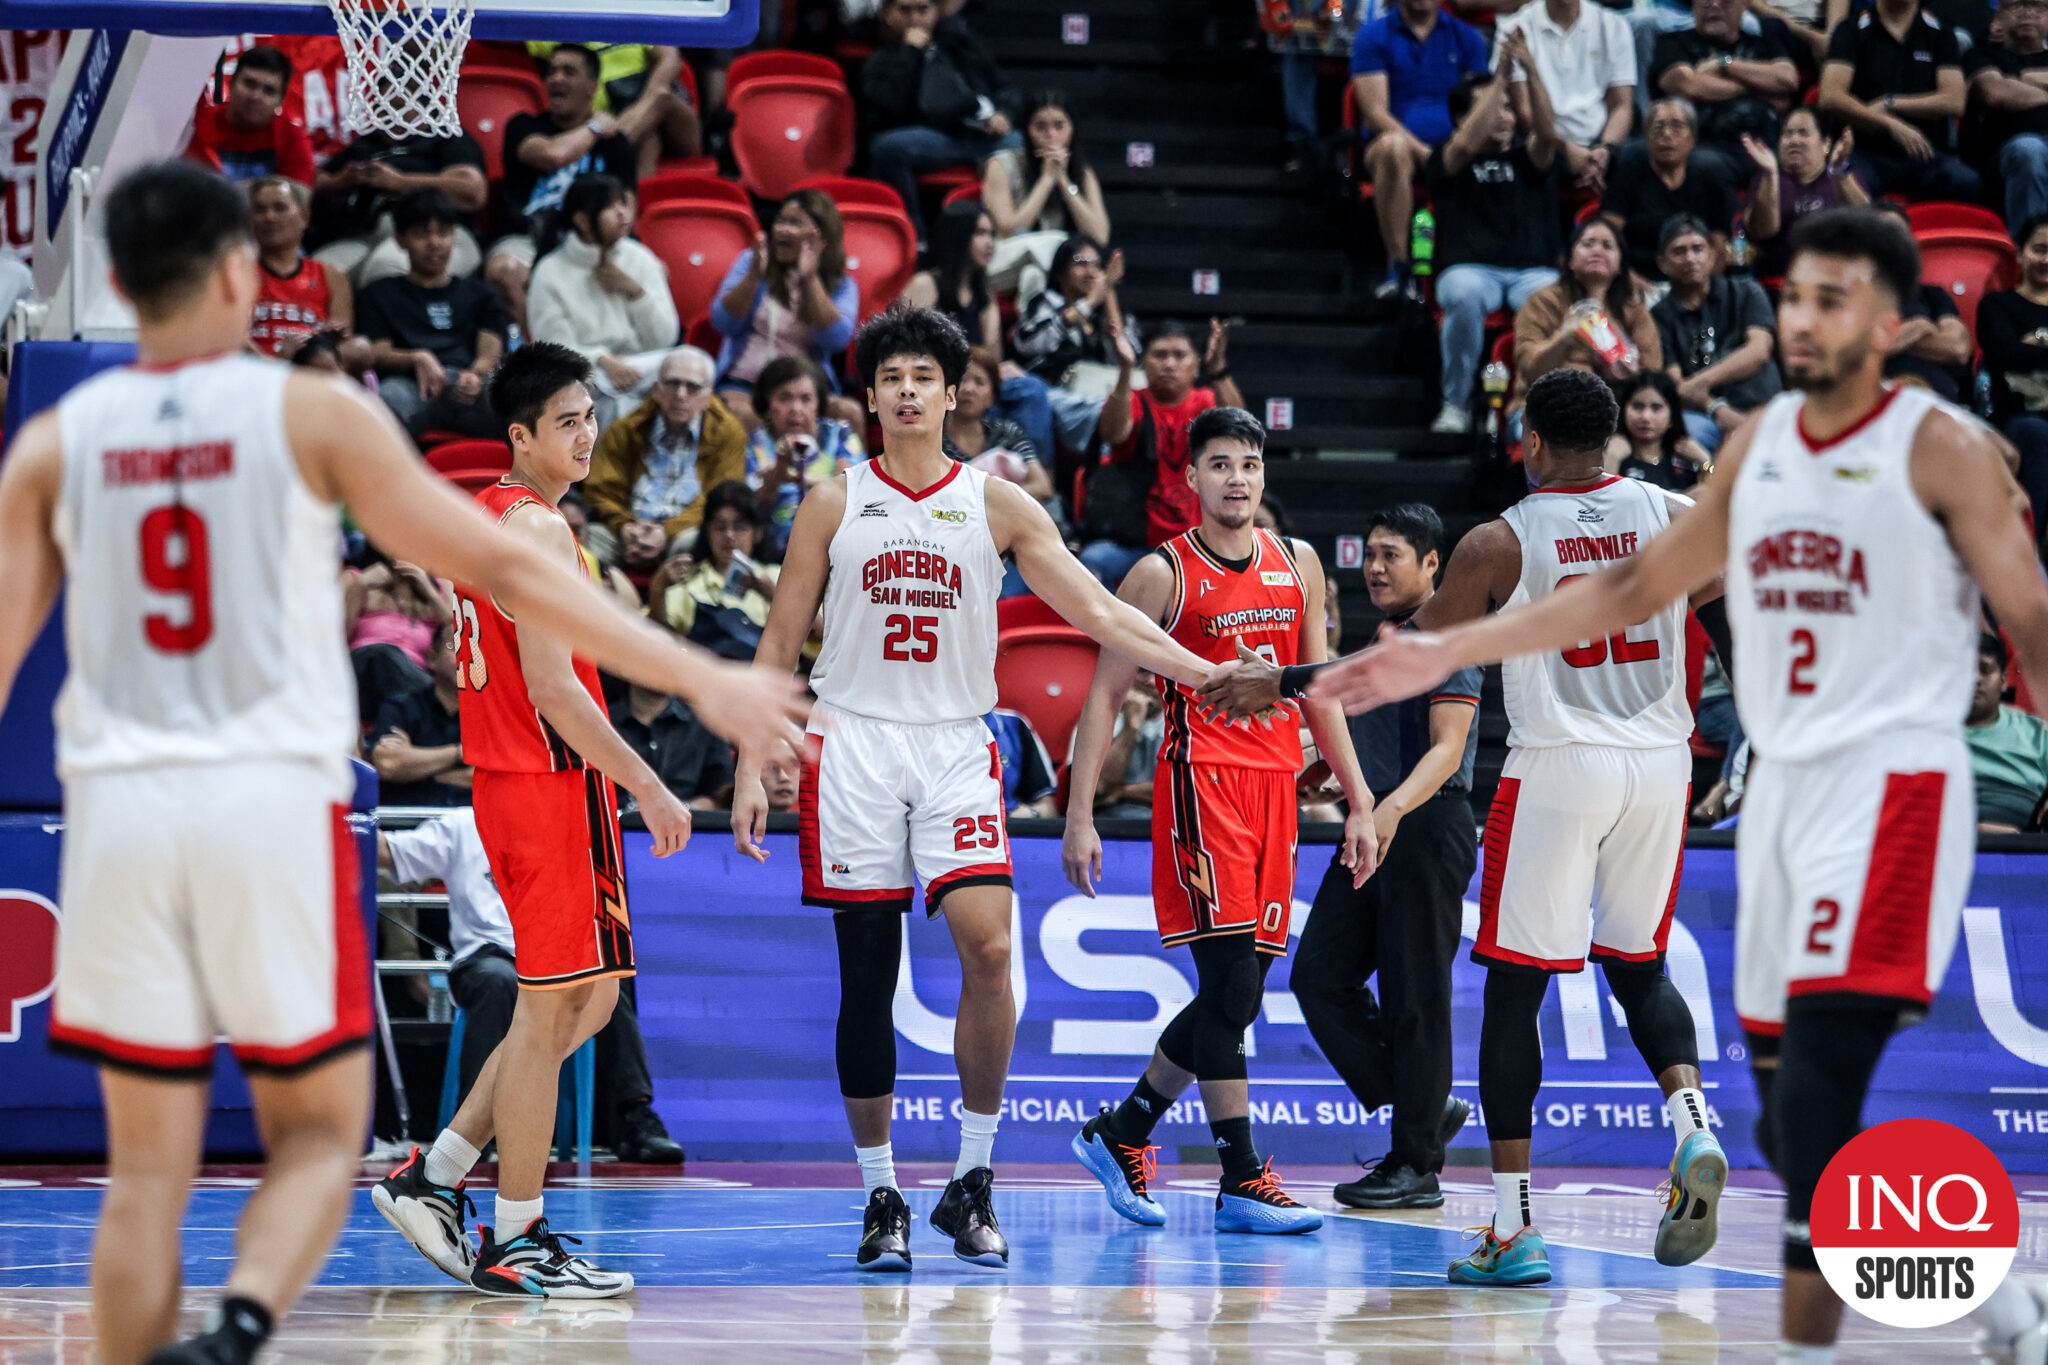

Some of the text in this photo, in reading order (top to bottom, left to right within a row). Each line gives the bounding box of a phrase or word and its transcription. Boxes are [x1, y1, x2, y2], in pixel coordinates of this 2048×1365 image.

[883, 538, 946, 553] BARANGAY
[139, 503, 215, 656] 9
[862, 550, 962, 600] GINEBRA
[871, 587, 957, 610] SAN MIGUEL
[1216, 607, 1298, 629] NORTHPORT
[883, 613, 939, 663] 25
[1788, 628, 1818, 697] 2
[952, 814, 999, 852] 25
[1805, 897, 1840, 955] 2
[891, 1098, 944, 1120] THE
[950, 1098, 1092, 1121] OFICIAL
[1546, 1104, 1588, 1127] OF
[1593, 1104, 1653, 1127] THE
[1660, 1104, 1724, 1128] PA
[1992, 1109, 2048, 1133] THE
